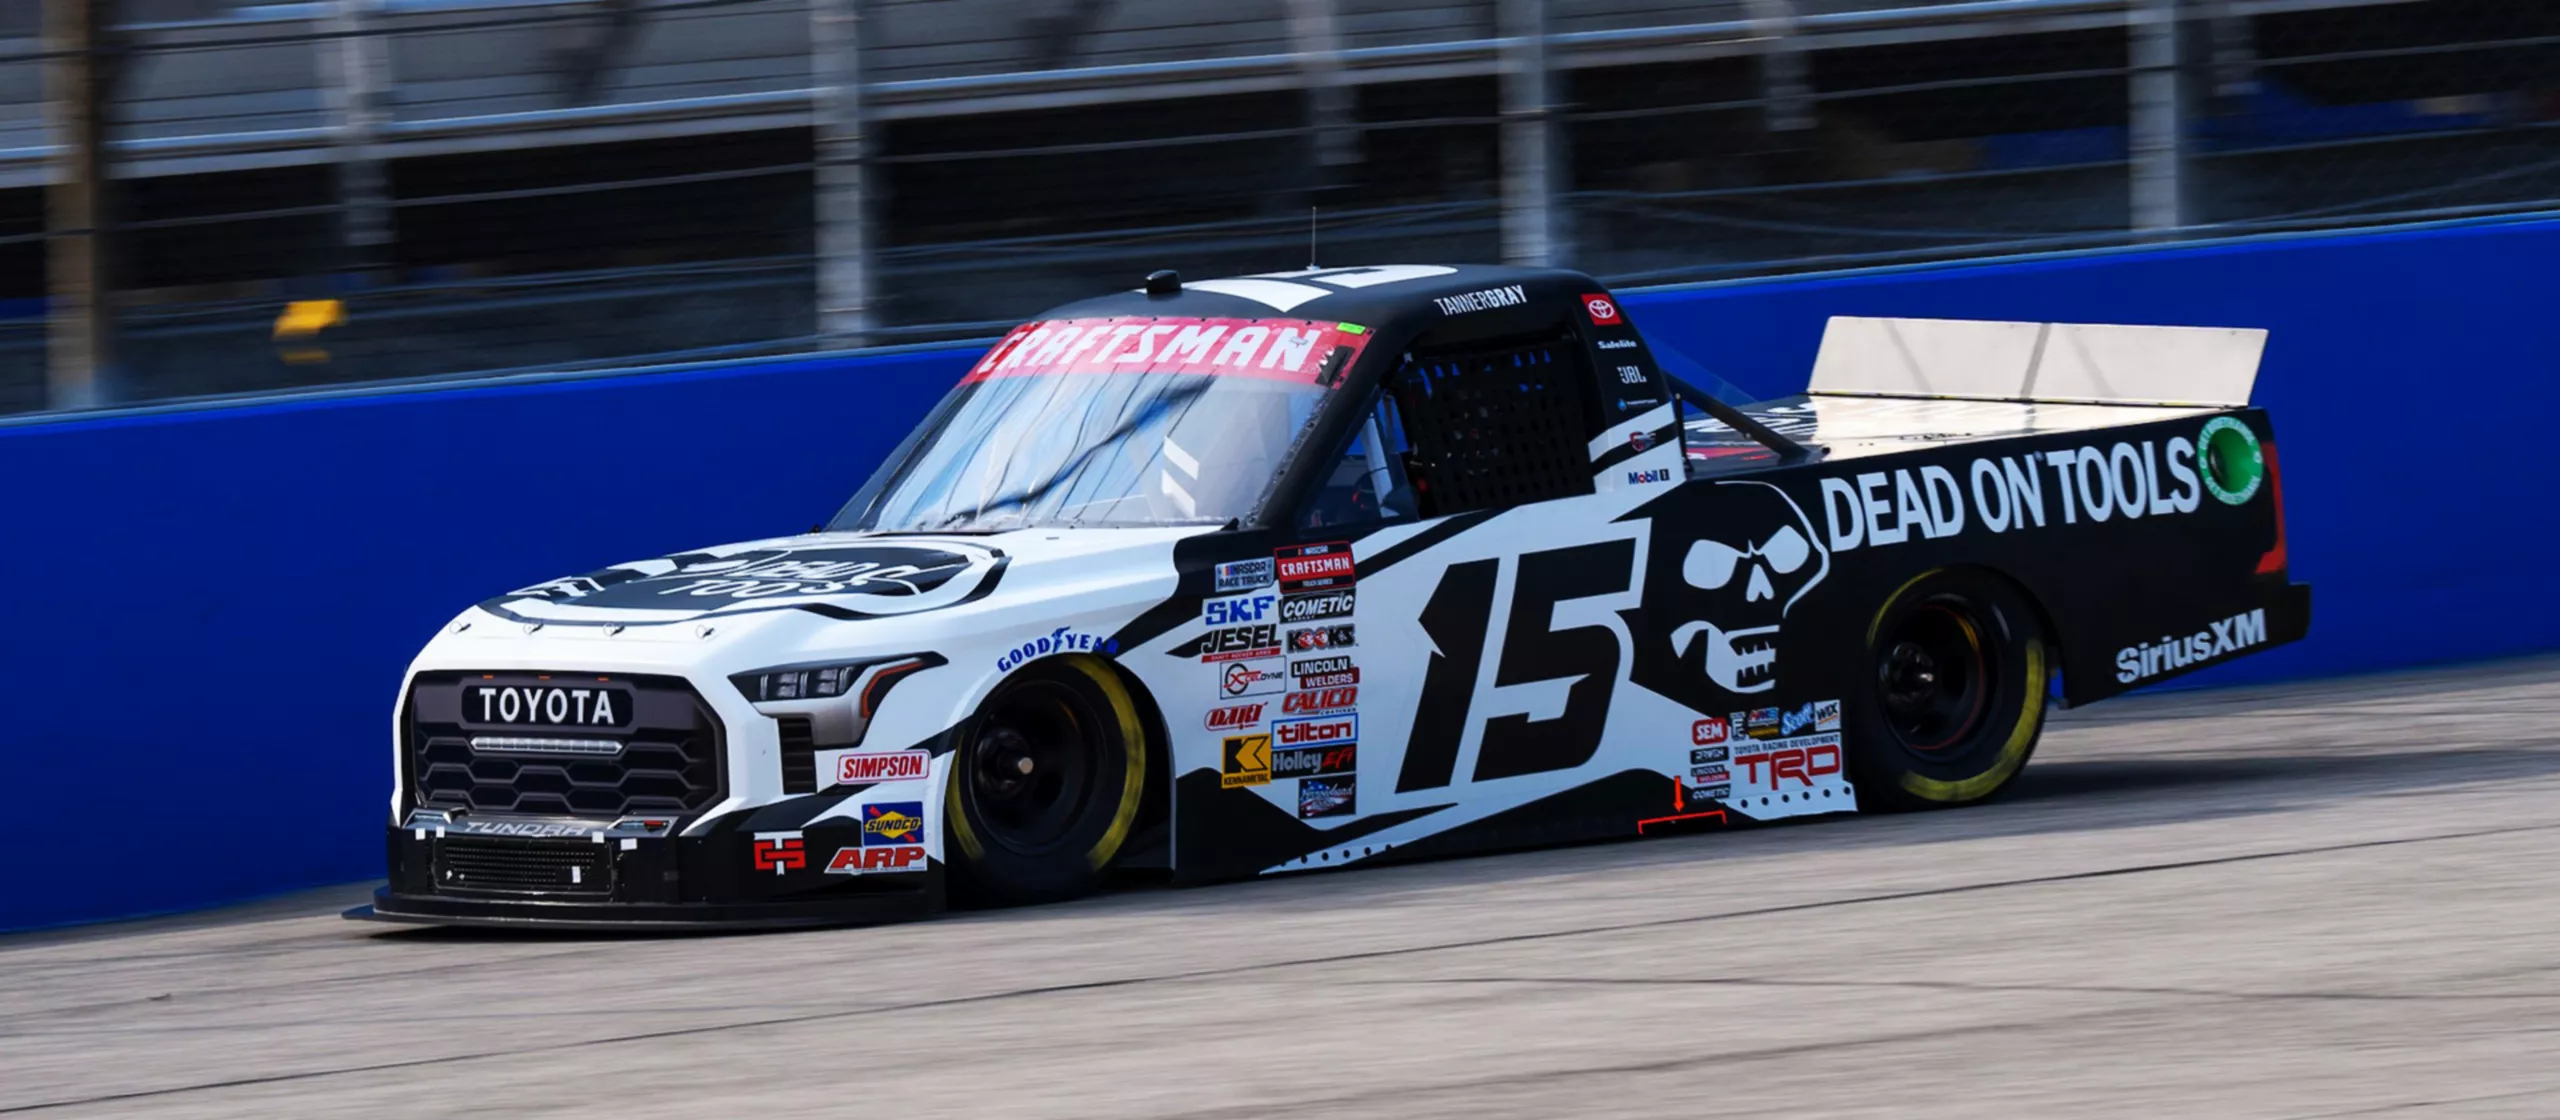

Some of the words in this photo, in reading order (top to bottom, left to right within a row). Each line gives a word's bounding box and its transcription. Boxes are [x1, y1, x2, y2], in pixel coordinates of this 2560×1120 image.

[978, 322, 1321, 372] CRAFTSMAN
[1617, 366, 1647, 384] JBL
[1628, 470, 1659, 485] Mobil
[1820, 465, 1965, 552] DEAD
[1971, 453, 2046, 533] ON
[2046, 436, 2200, 524] TOOLS
[1234, 562, 1266, 574] NASCAR
[1280, 557, 1350, 576] CRAFTSMAN
[1218, 577, 1240, 588] RACE
[1241, 574, 1269, 586] TRUCK
[1205, 595, 1275, 626] SKF
[1283, 595, 1354, 618] COMETIC
[997, 626, 1119, 672] GOODYEAR
[1201, 624, 1282, 654] JESEL
[1287, 625, 1355, 653] KOOKS
[2116, 607, 2268, 683] SiriusXM
[1293, 658, 1348, 675] LINCOLN
[1395, 537, 1636, 794] 15
[1305, 673, 1353, 687] WELDERS
[479, 687, 615, 725] TOYOTA
[1282, 686, 1358, 713] CALICO
[1208, 703, 1264, 727] DART
[1817, 702, 1838, 721] WIX
[1277, 722, 1352, 744] tilton
[1696, 722, 1723, 740] SEM
[1762, 740, 1789, 751] RACING
[1789, 734, 1839, 749] DEVELOPMENT
[843, 755, 923, 780] SIMPSON
[1272, 751, 1323, 773] Holley
[1734, 744, 1840, 791] TRD
[461, 821, 587, 837] TUNDRA
[866, 817, 921, 832] SUNOCO
[830, 846, 925, 869] ARP
